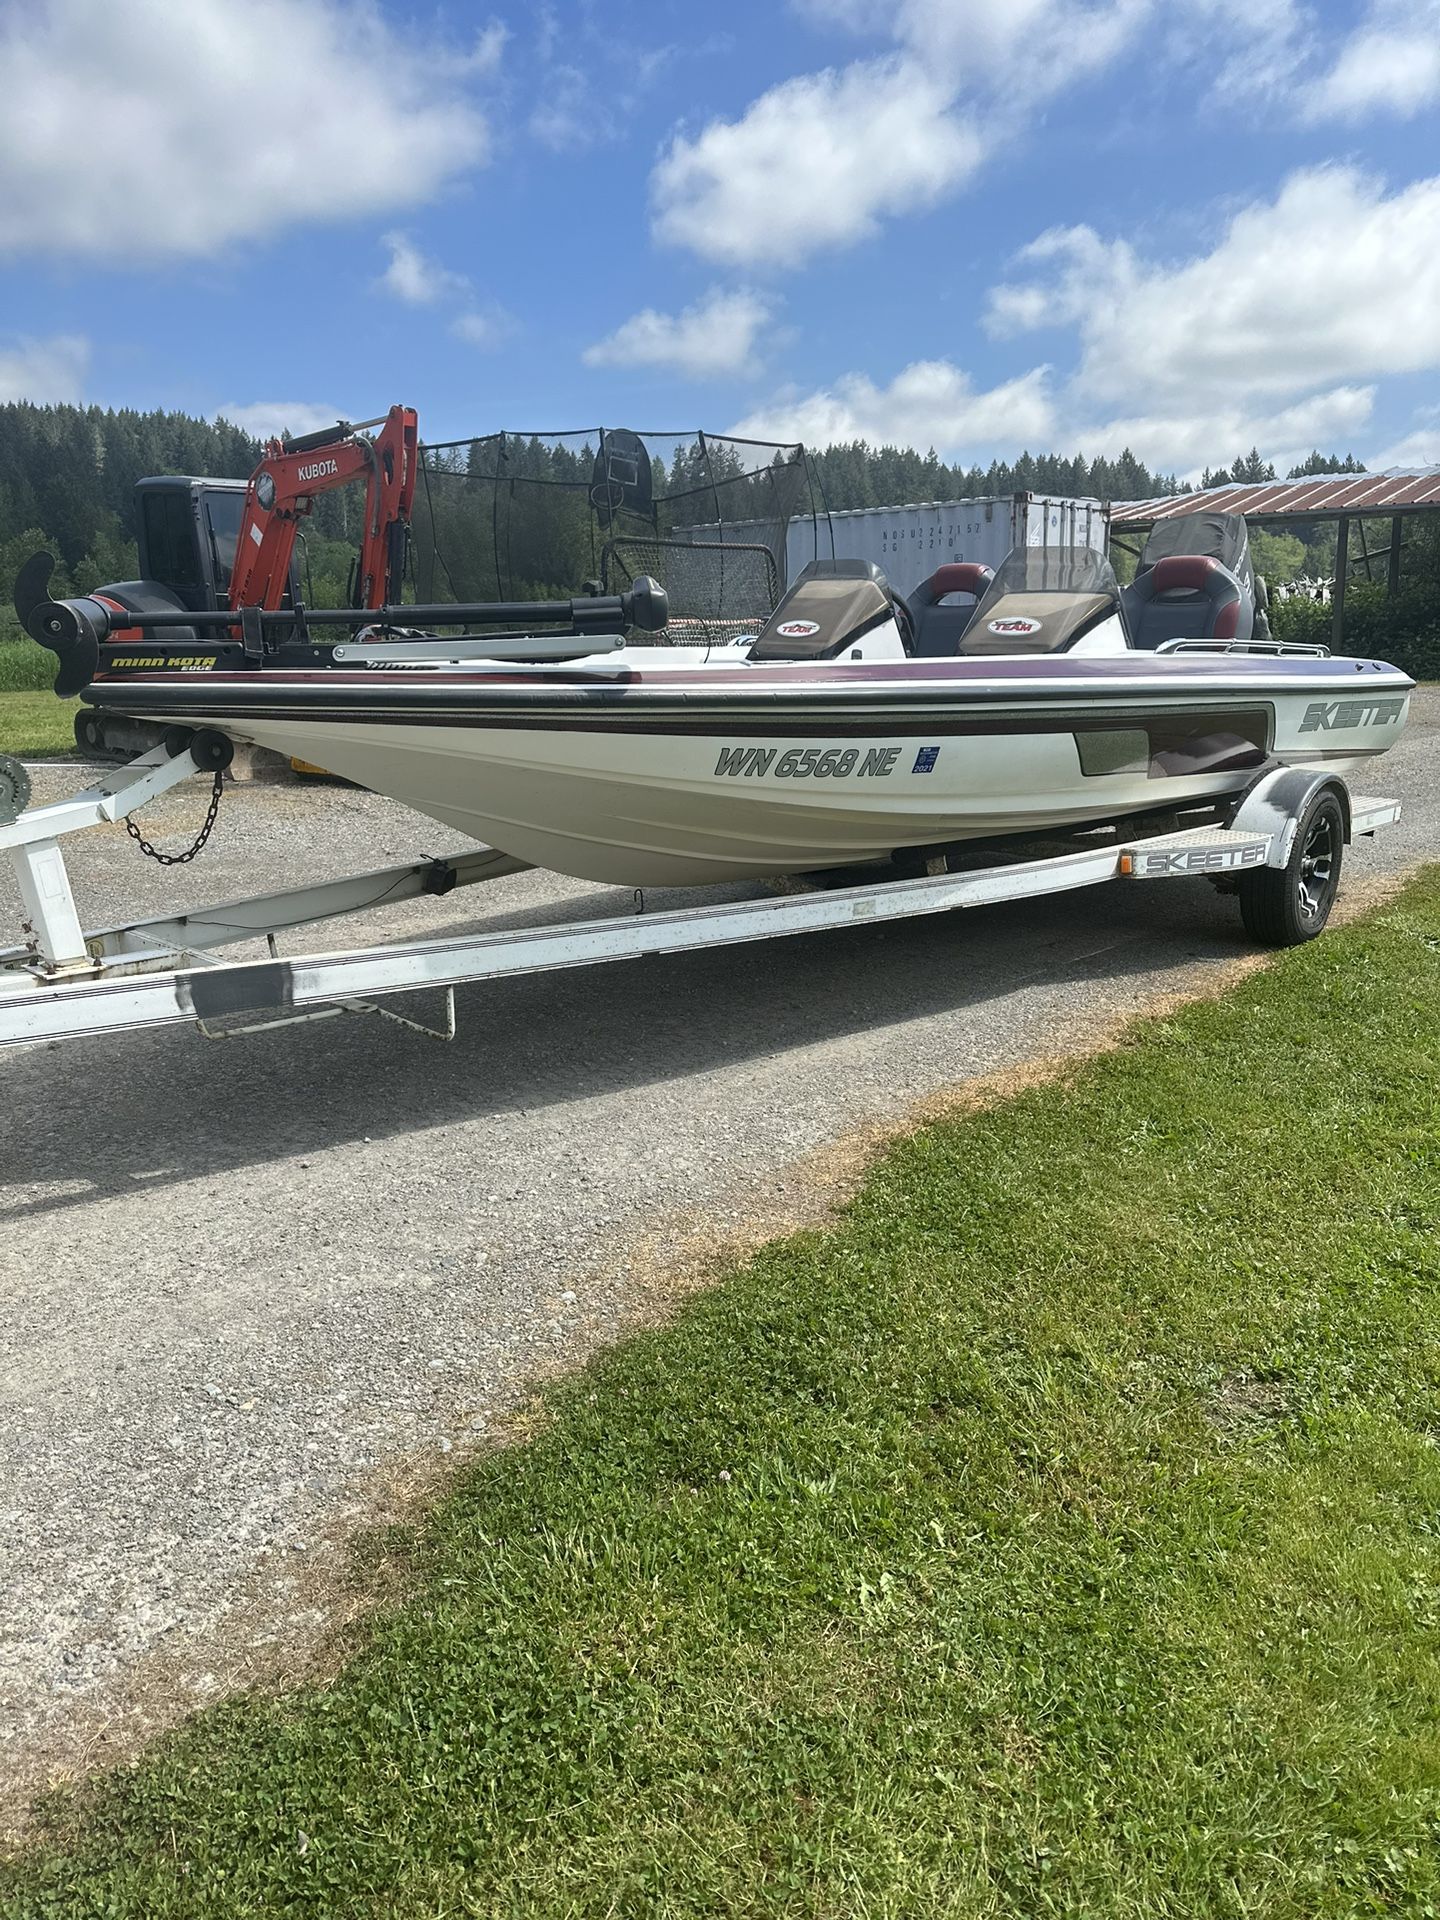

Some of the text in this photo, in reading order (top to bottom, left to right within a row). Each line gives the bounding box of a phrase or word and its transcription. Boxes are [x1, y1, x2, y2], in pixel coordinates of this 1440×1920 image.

[298, 459, 339, 481] KUBOTA
[783, 625, 813, 634] TEAM
[994, 623, 1033, 632] TEAM
[167, 656, 217, 667] KOTA
[1298, 698, 1405, 733] SKEETER
[714, 747, 903, 778] WN 6568 NE
[913, 764, 933, 772] 2021
[1146, 844, 1267, 873] SKEETER
